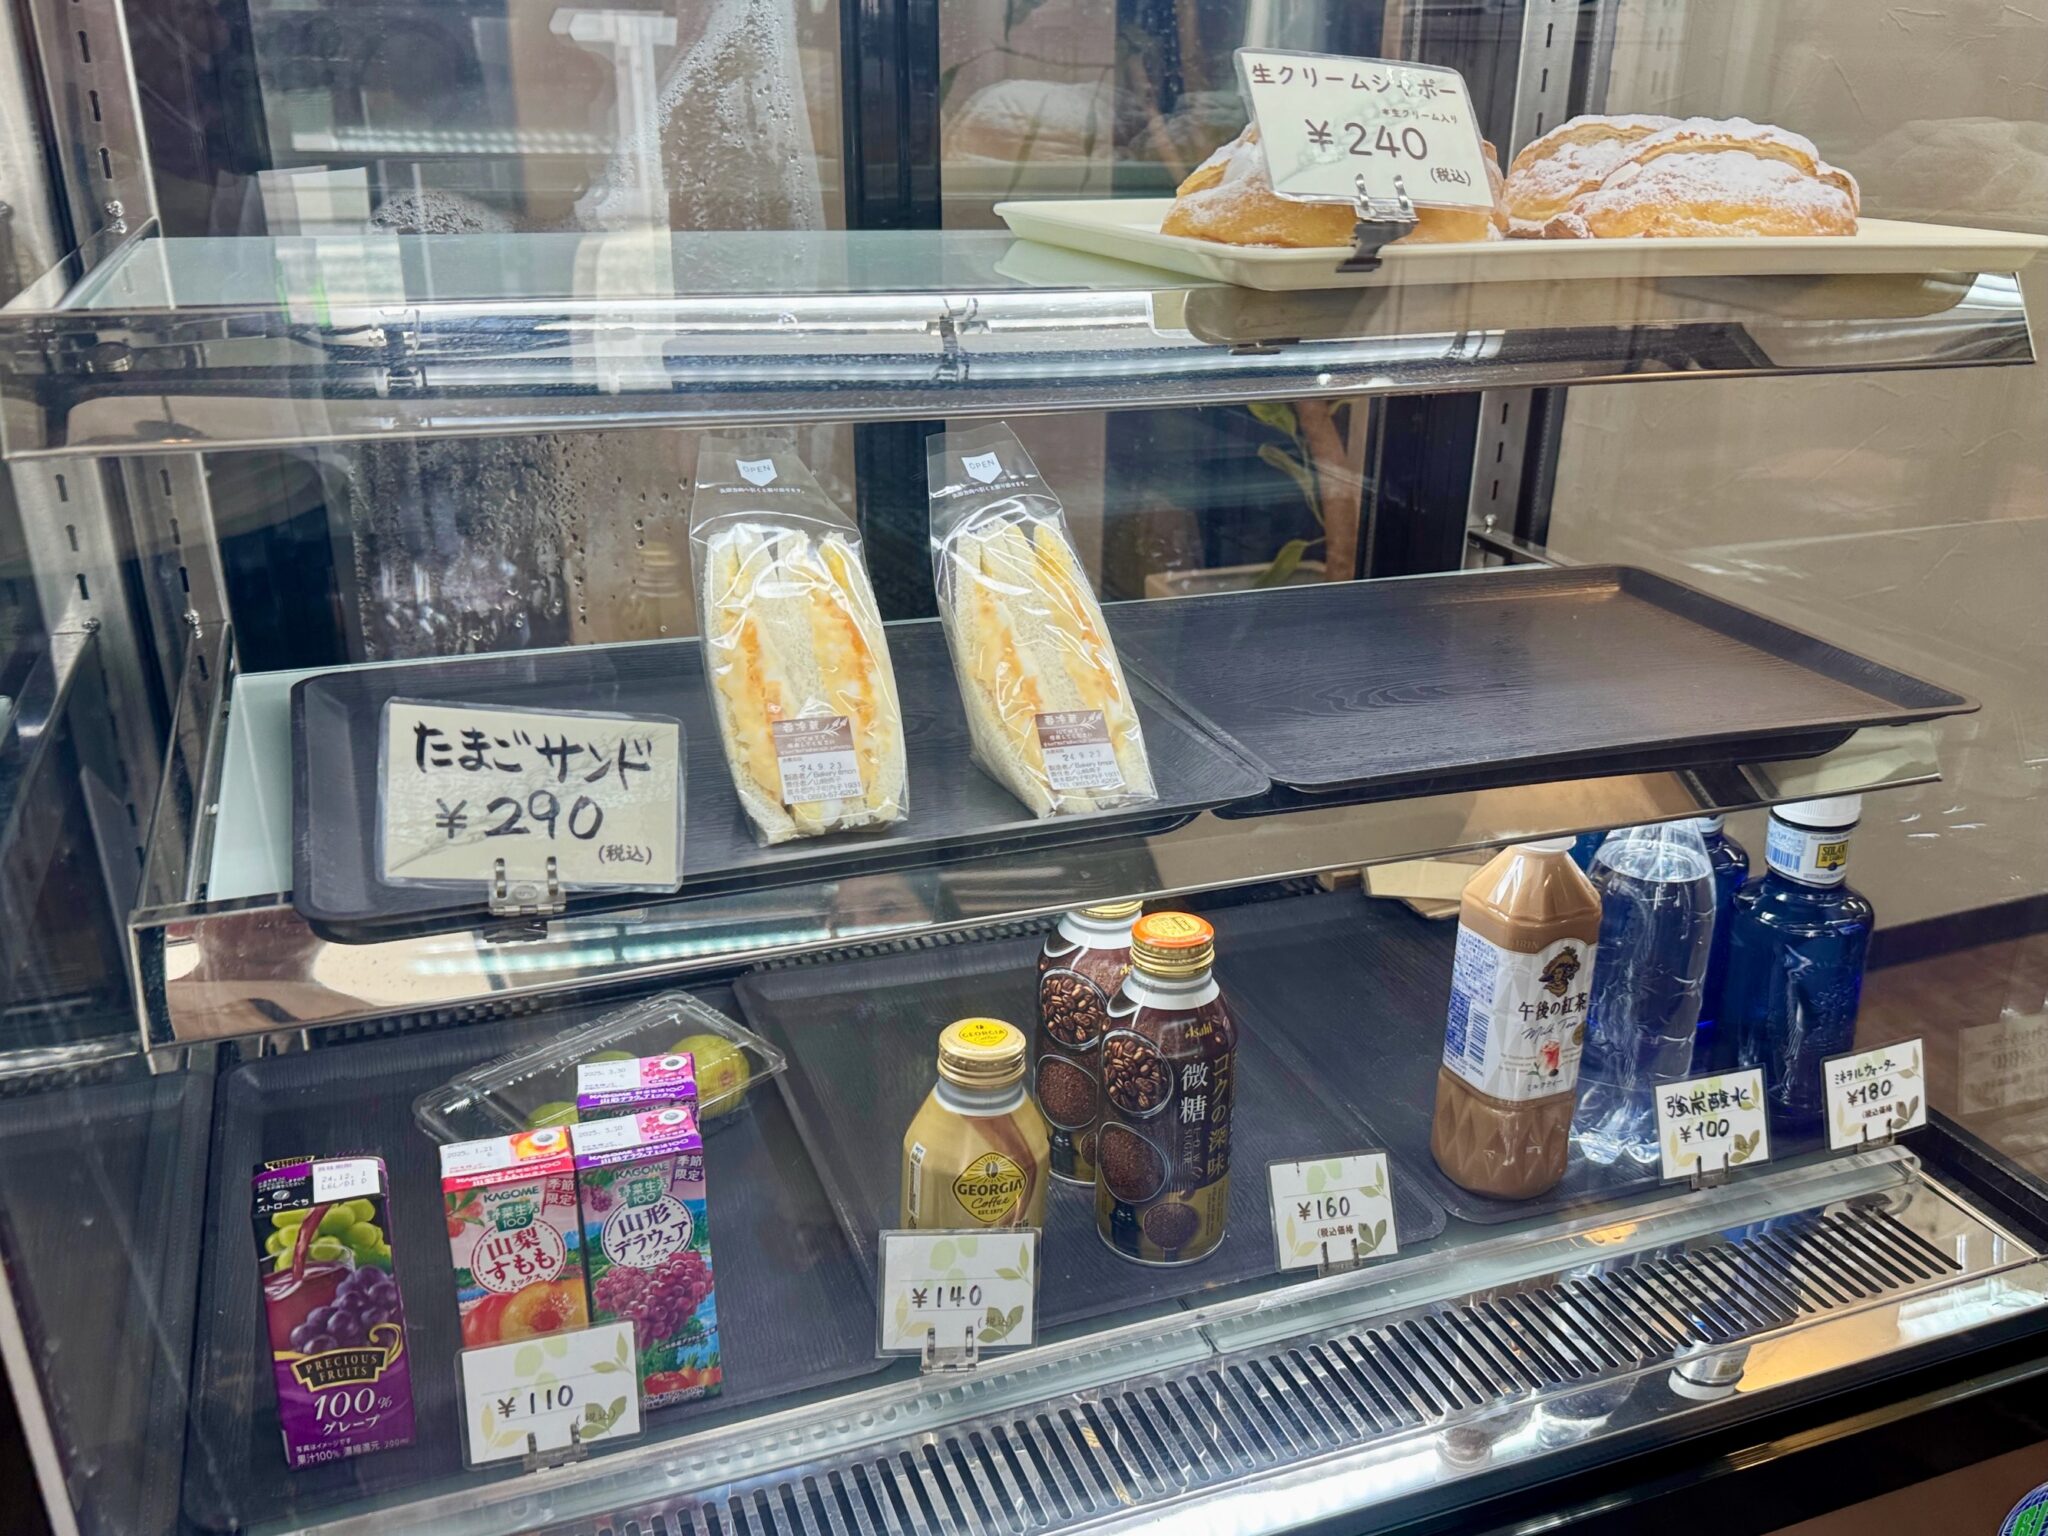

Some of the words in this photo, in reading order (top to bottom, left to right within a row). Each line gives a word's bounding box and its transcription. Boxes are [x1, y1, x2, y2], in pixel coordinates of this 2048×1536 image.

[742, 465, 771, 473] OPEN
[968, 458, 995, 470] OPEN
[413, 720, 653, 790] たまごサンド
[1518, 992, 1588, 1021] 午後の紅茶
[1184, 1022, 1213, 1040] Asahi
[1834, 1059, 1896, 1085] ミネラルウォーター
[1180, 1062, 1209, 1124] 微糖
[1664, 1087, 1751, 1119] 強炭酸水
[1847, 1079, 1893, 1106] ¥180
[1680, 1119, 1730, 1143] ¥100
[614, 1160, 669, 1180] KAGOME
[676, 1155, 703, 1168] 季節
[547, 1177, 575, 1190] 季節
[674, 1168, 701, 1182] 限定
[483, 1186, 539, 1203] KAGOME
[633, 1192, 656, 1205] 100
[957, 1179, 1023, 1197] GEORGIA
[257, 1198, 310, 1213] ストローぐち
[545, 1192, 573, 1206] 限定
[970, 1195, 1011, 1210] Coffee
[1297, 1196, 1351, 1221] ¥160
[503, 1216, 527, 1228] 100
[618, 1203, 672, 1237] 山形
[486, 1226, 542, 1261] 山梨
[613, 1221, 689, 1262] デラウェア
[485, 1248, 556, 1285] すもも
[912, 1285, 983, 1308] ¥140
[305, 1354, 378, 1374] PRECIOUS
[319, 1366, 368, 1383] FRUITS
[314, 1387, 393, 1421] 100%
[497, 1385, 574, 1419] ¥110
[322, 1413, 381, 1436] グレープ
